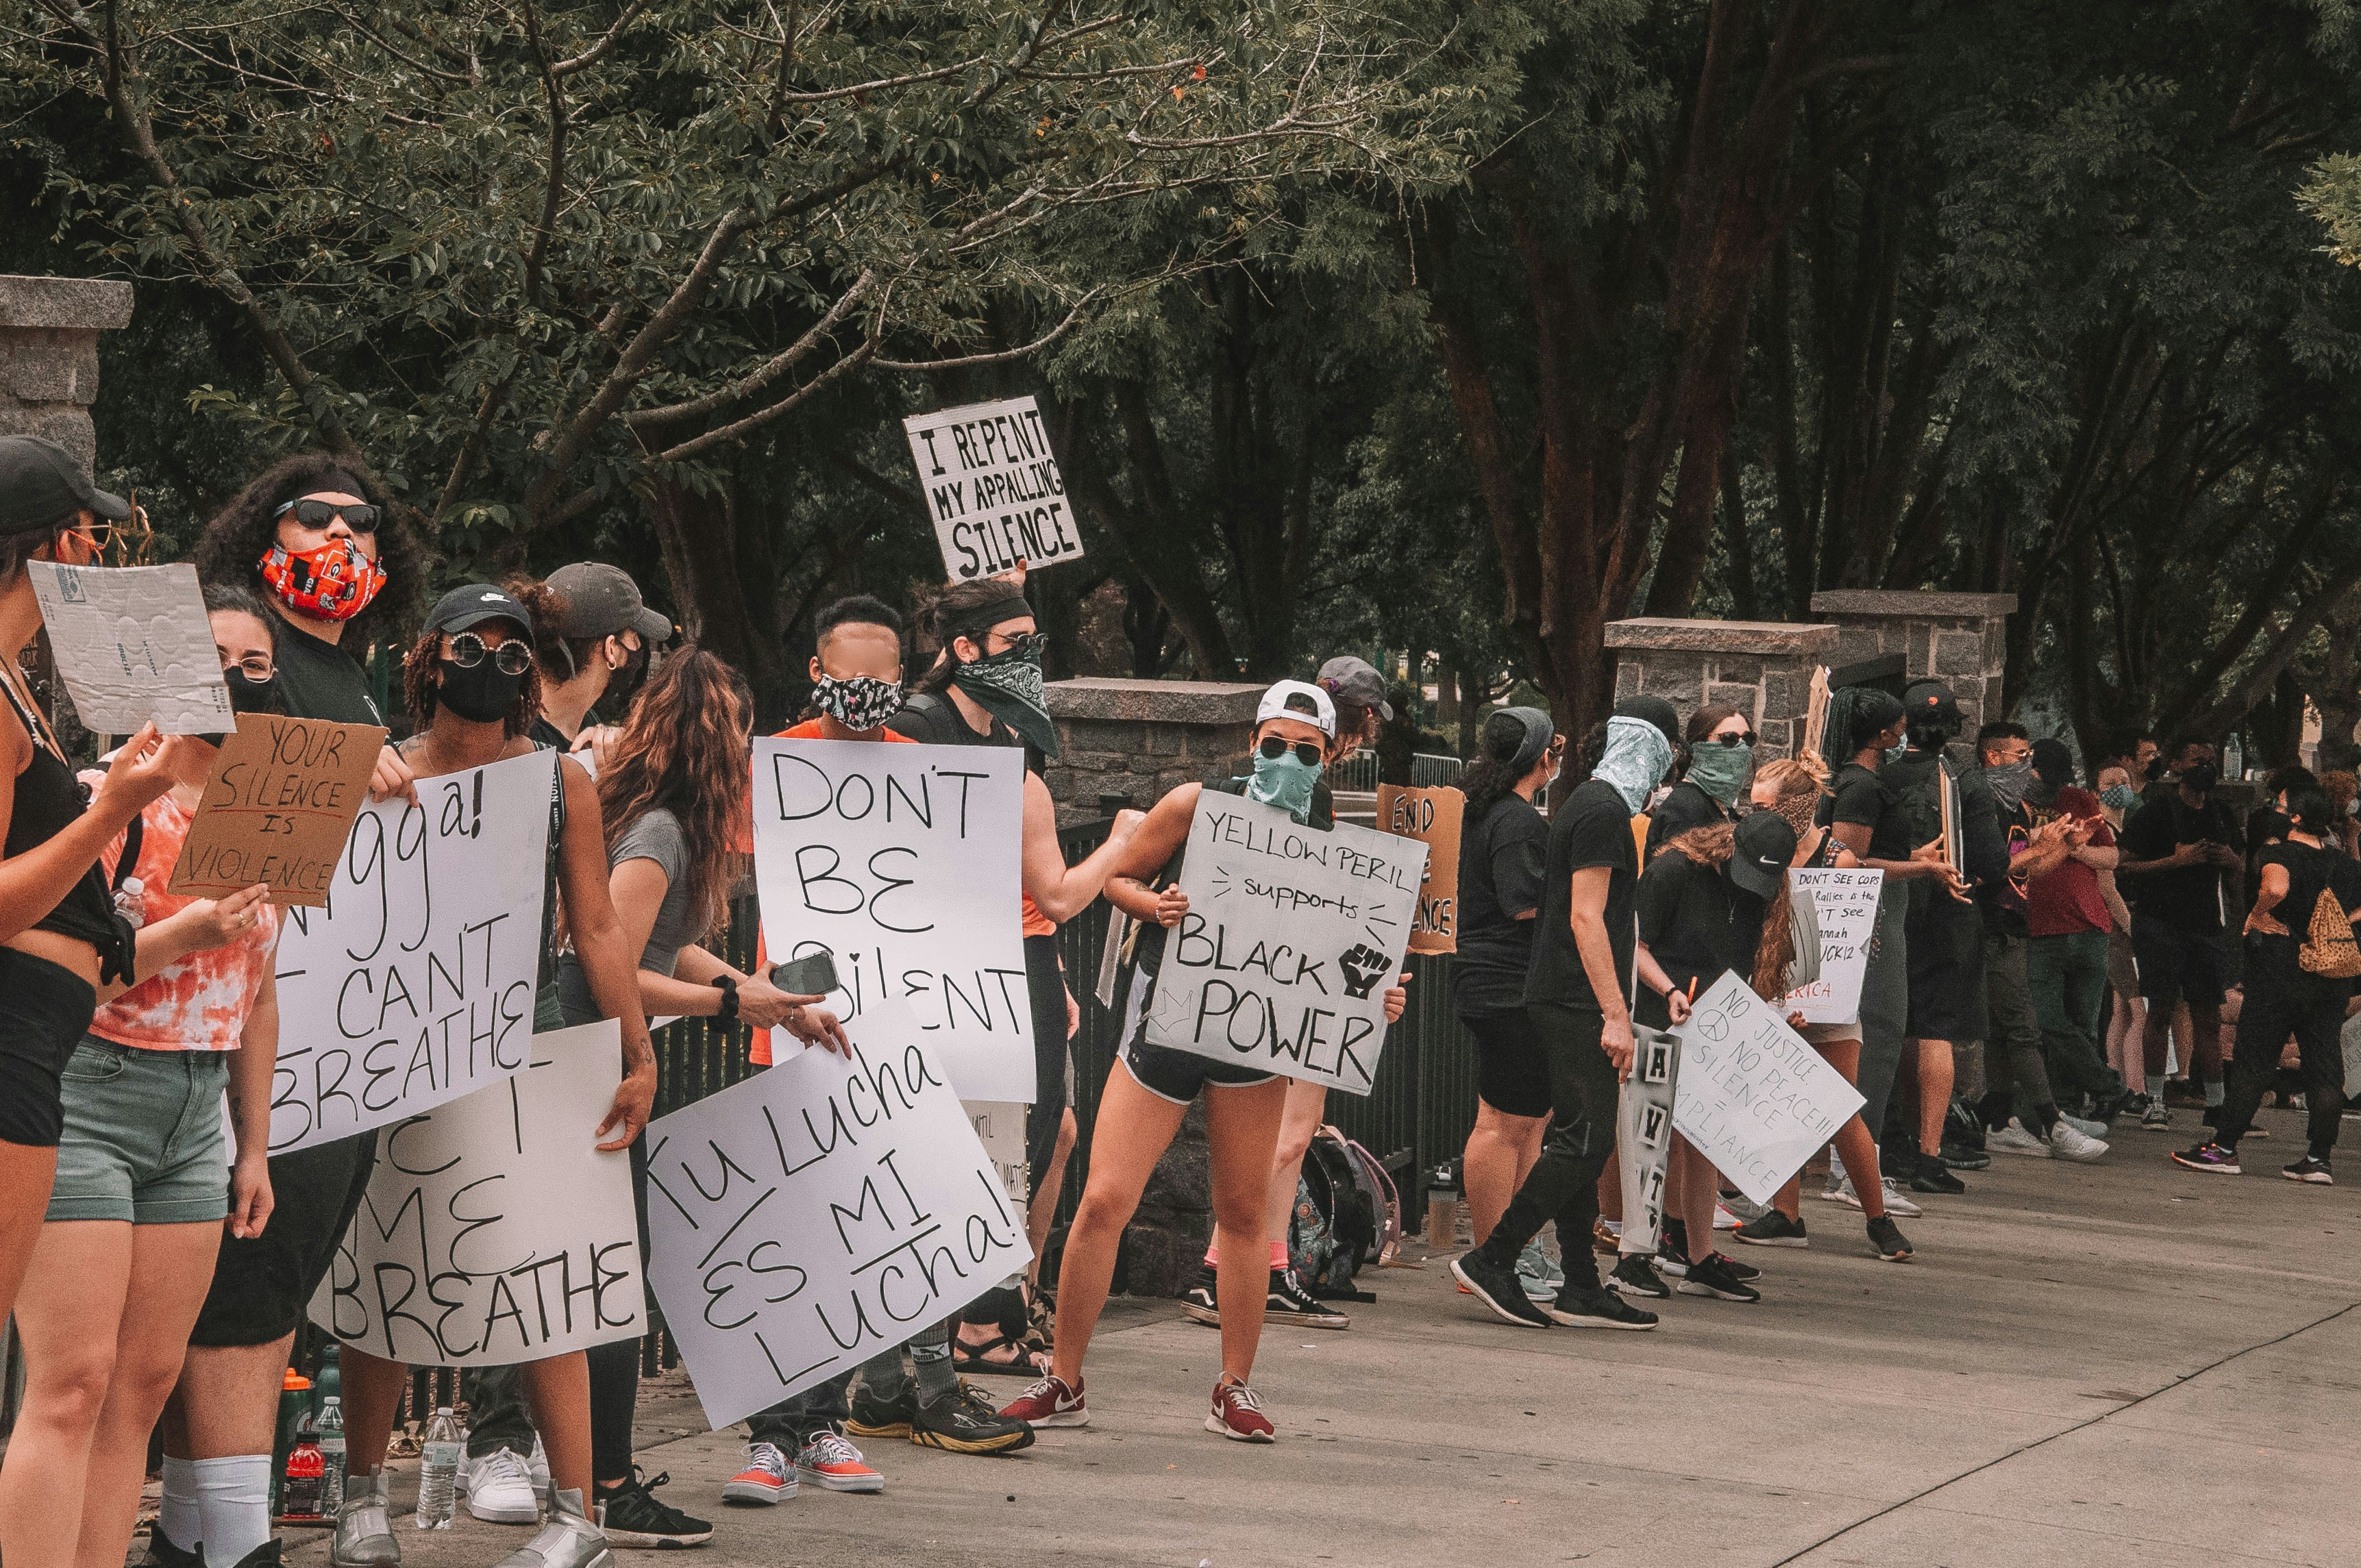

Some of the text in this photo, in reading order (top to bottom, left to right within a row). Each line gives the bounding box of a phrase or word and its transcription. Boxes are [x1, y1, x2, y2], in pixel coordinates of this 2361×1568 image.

[919, 410, 1046, 476] I REPENT
[932, 458, 1065, 521] MY APPALLING
[952, 502, 1076, 578] SILENCE
[270, 721, 347, 769] YOUR
[213, 762, 346, 808] SILENCE
[260, 814, 295, 834] IS
[773, 753, 991, 839] DON'T
[1392, 793, 1435, 834] END
[188, 845, 332, 891] VIOLENCE
[795, 843, 935, 934] BE
[1206, 811, 1327, 867] YELLOW
[1336, 846, 1414, 894] PERIL
[1798, 872, 1880, 885] DON'T SEE COPS
[1244, 878, 1359, 919] supports
[336, 912, 510, 1039] CAN'T
[1176, 912, 1328, 995] BLACK
[1194, 979, 1373, 1086] POWER
[1719, 988, 1751, 1019] NO
[268, 980, 530, 1149] BREATHE
[1692, 1045, 1783, 1130] SILENCE
[1728, 1040, 1761, 1072] NO
[762, 1042, 943, 1177] Lucha
[353, 1174, 536, 1286] ME
[702, 1148, 932, 1330] ES MI
[332, 1241, 635, 1361] BREATHE
